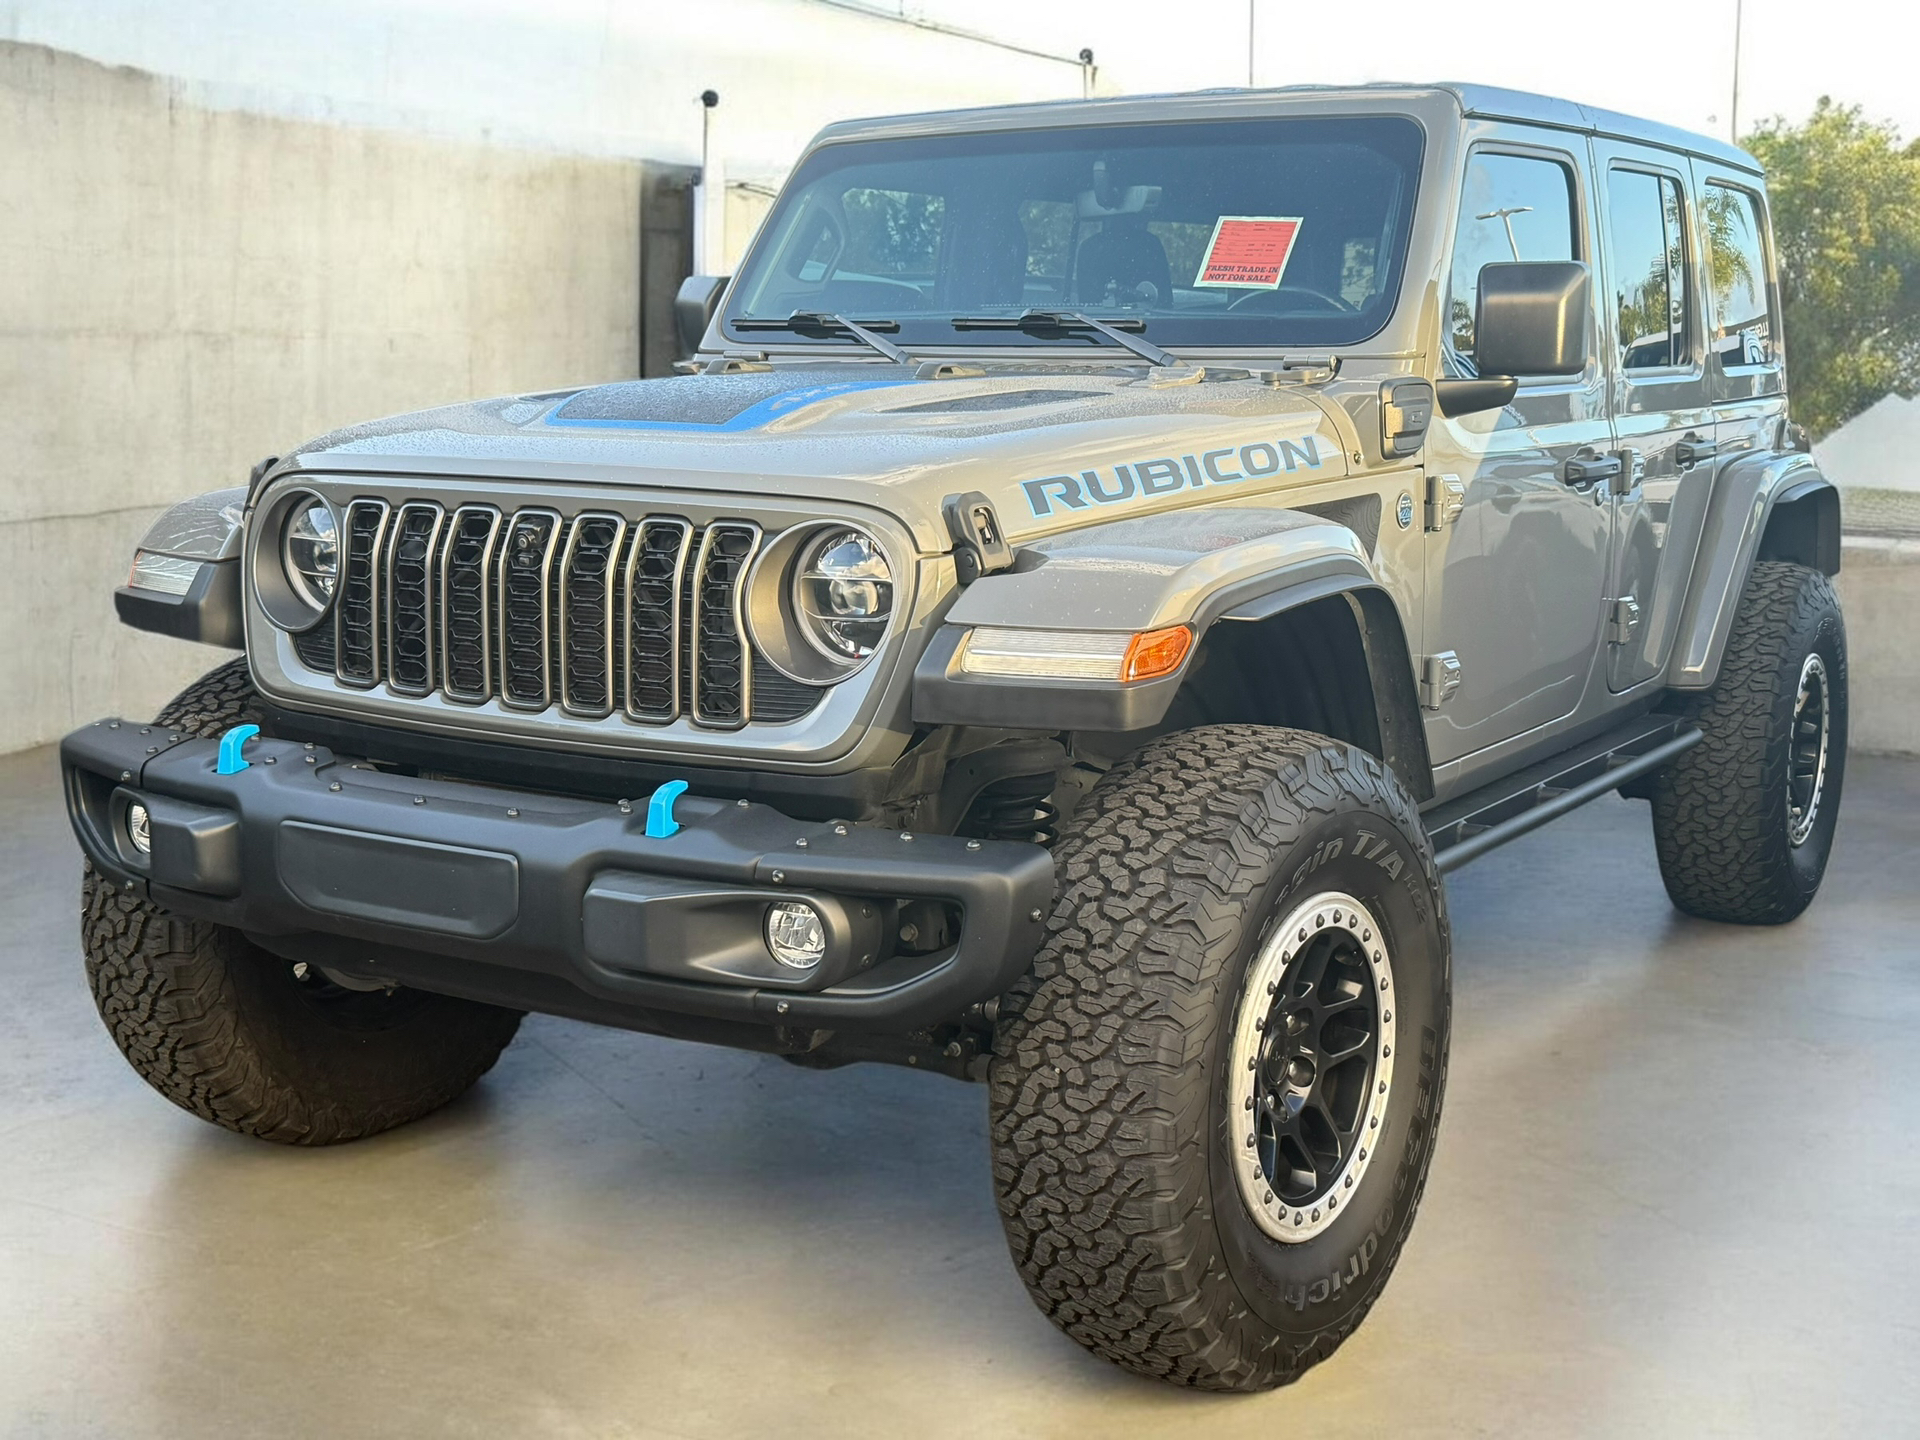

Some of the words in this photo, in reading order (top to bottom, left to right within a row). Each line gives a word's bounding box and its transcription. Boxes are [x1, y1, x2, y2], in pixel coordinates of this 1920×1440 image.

[1236, 266, 1279, 274] TRADE-IN
[1020, 435, 1323, 519] RUBICON
[1351, 829, 1405, 881] T/A
